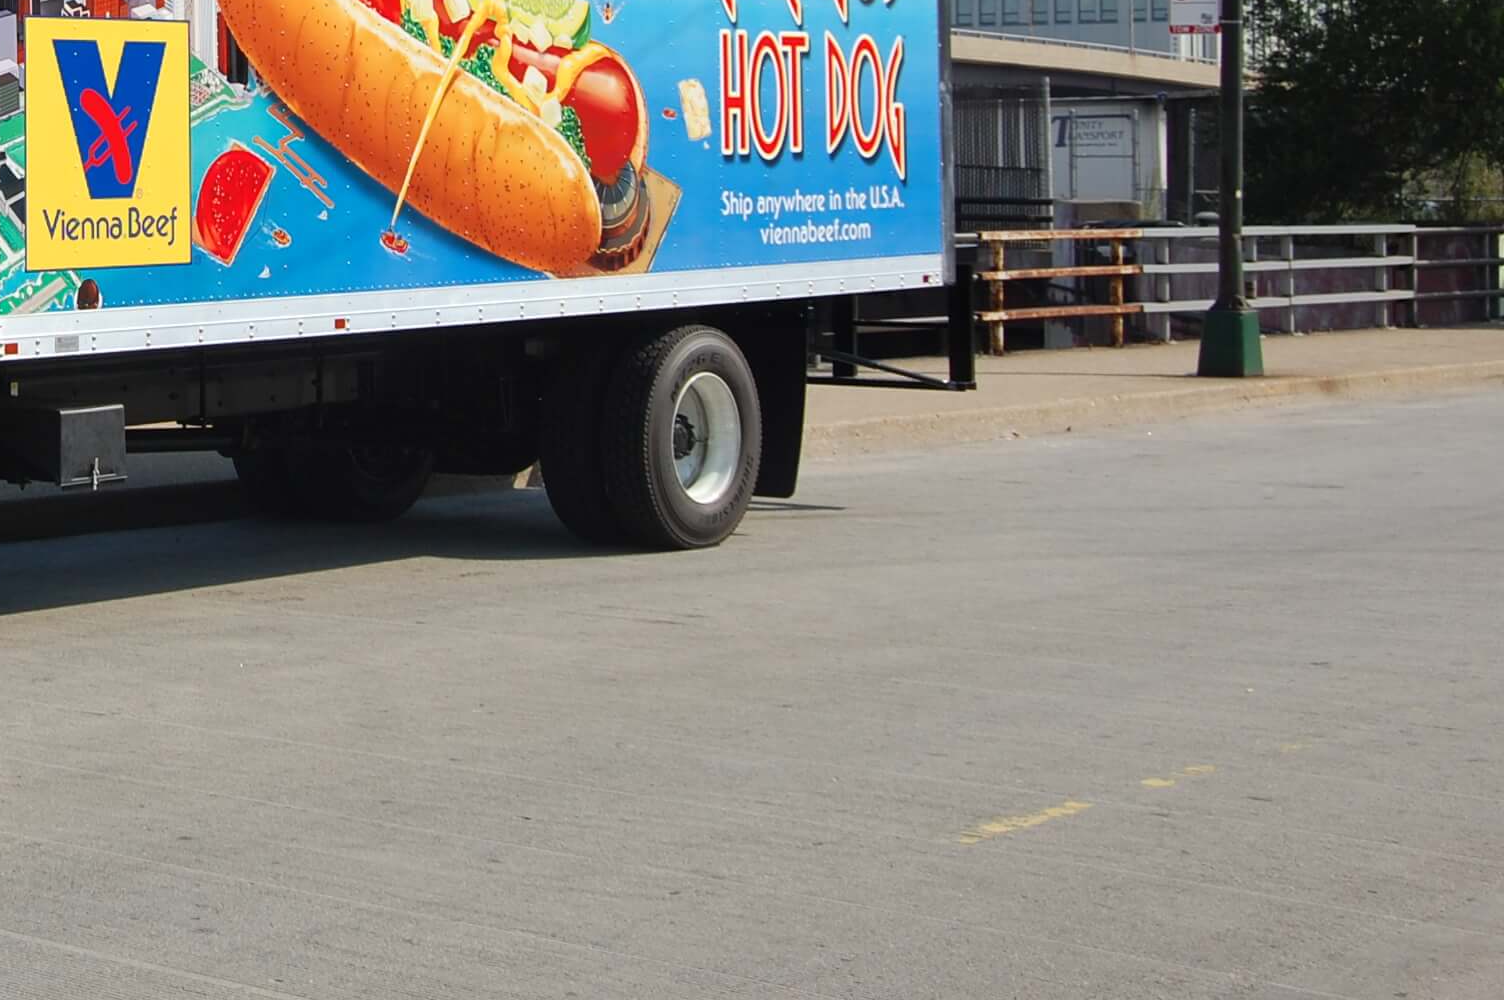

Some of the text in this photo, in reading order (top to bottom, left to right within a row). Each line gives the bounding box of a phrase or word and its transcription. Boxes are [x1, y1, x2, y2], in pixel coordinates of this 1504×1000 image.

[719, 29, 907, 181] HOT DOG
[721, 189, 754, 221] Ship
[756, 189, 826, 220] anywhere
[828, 189, 843, 211] in
[845, 187, 867, 210] the
[42, 206, 178, 246] Vienna Beef
[760, 218, 872, 245] viennabeef.com
